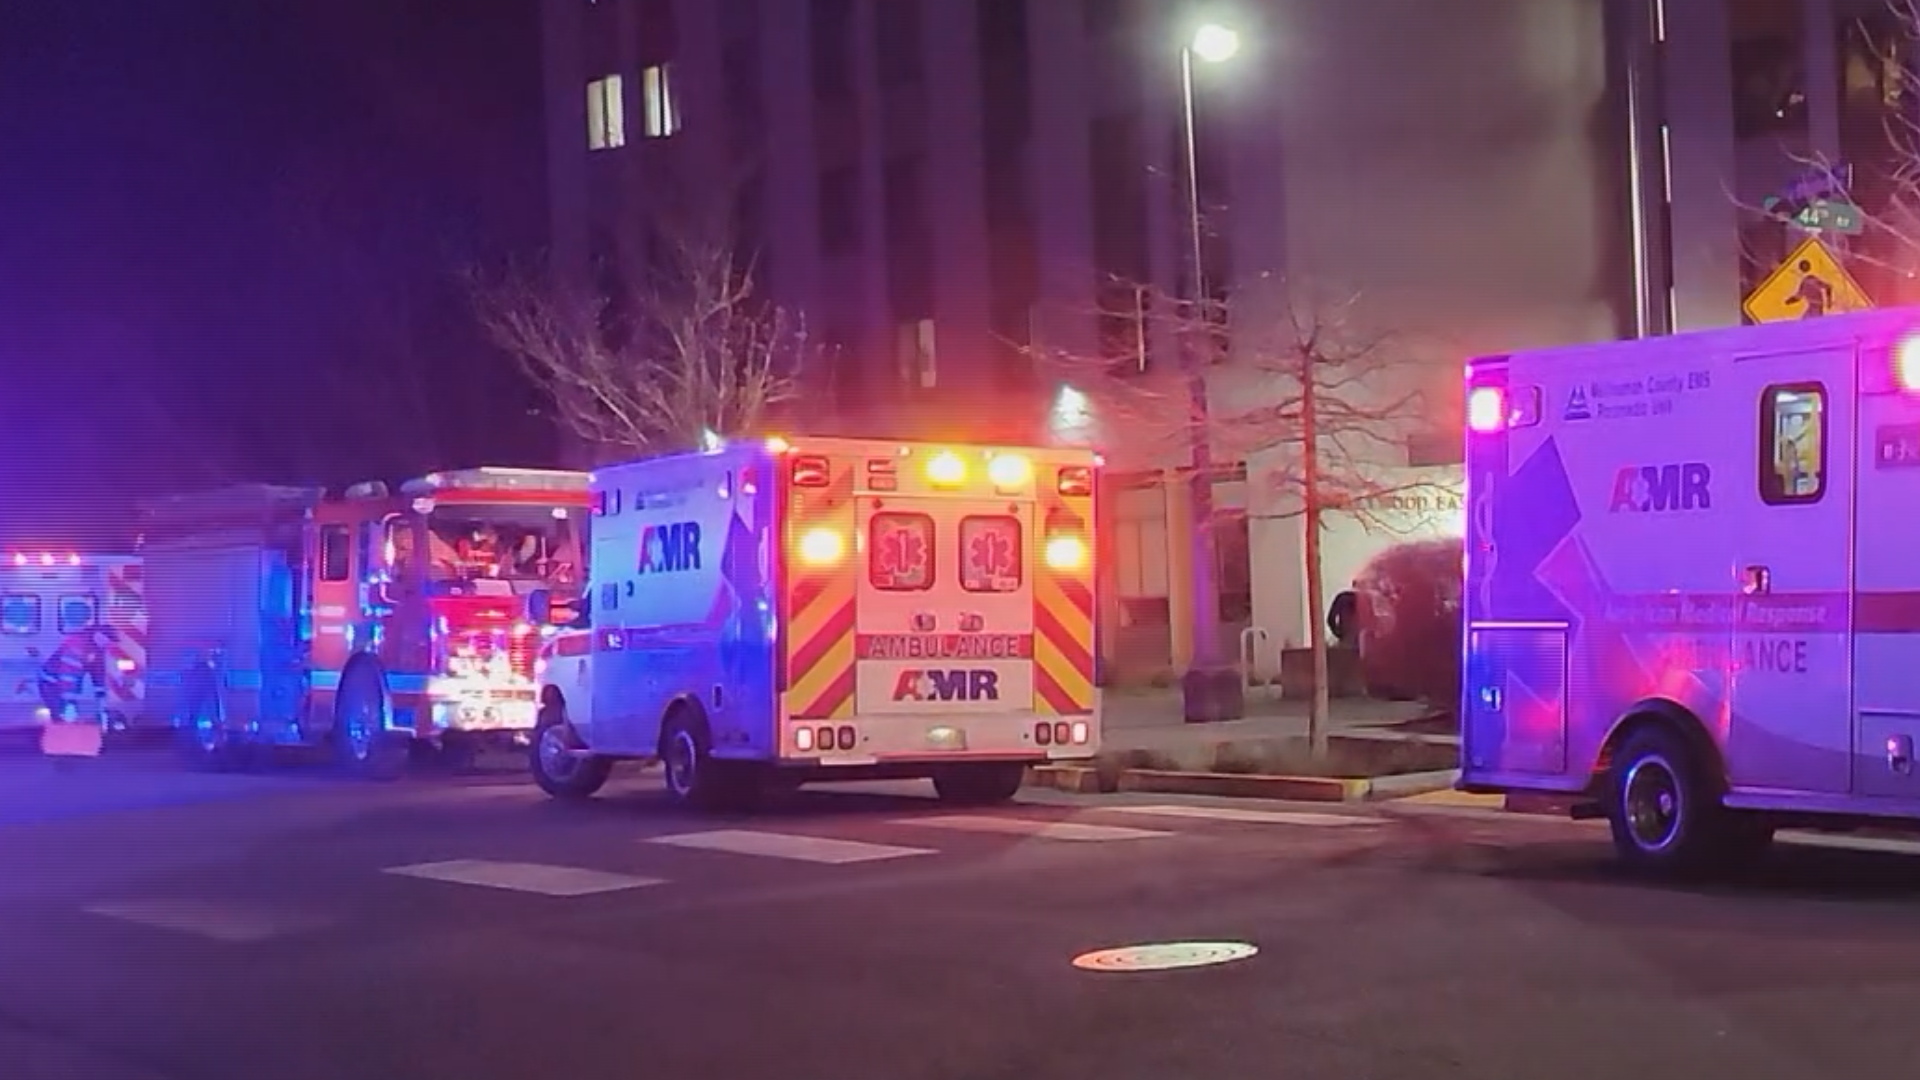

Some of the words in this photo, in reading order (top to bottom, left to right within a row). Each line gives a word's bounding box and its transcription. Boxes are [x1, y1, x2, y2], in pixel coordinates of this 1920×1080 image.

[1609, 462, 1711, 512] AMR
[637, 520, 701, 575] AMR
[871, 635, 1019, 658] AMBULANCE
[892, 669, 999, 702] AMR
